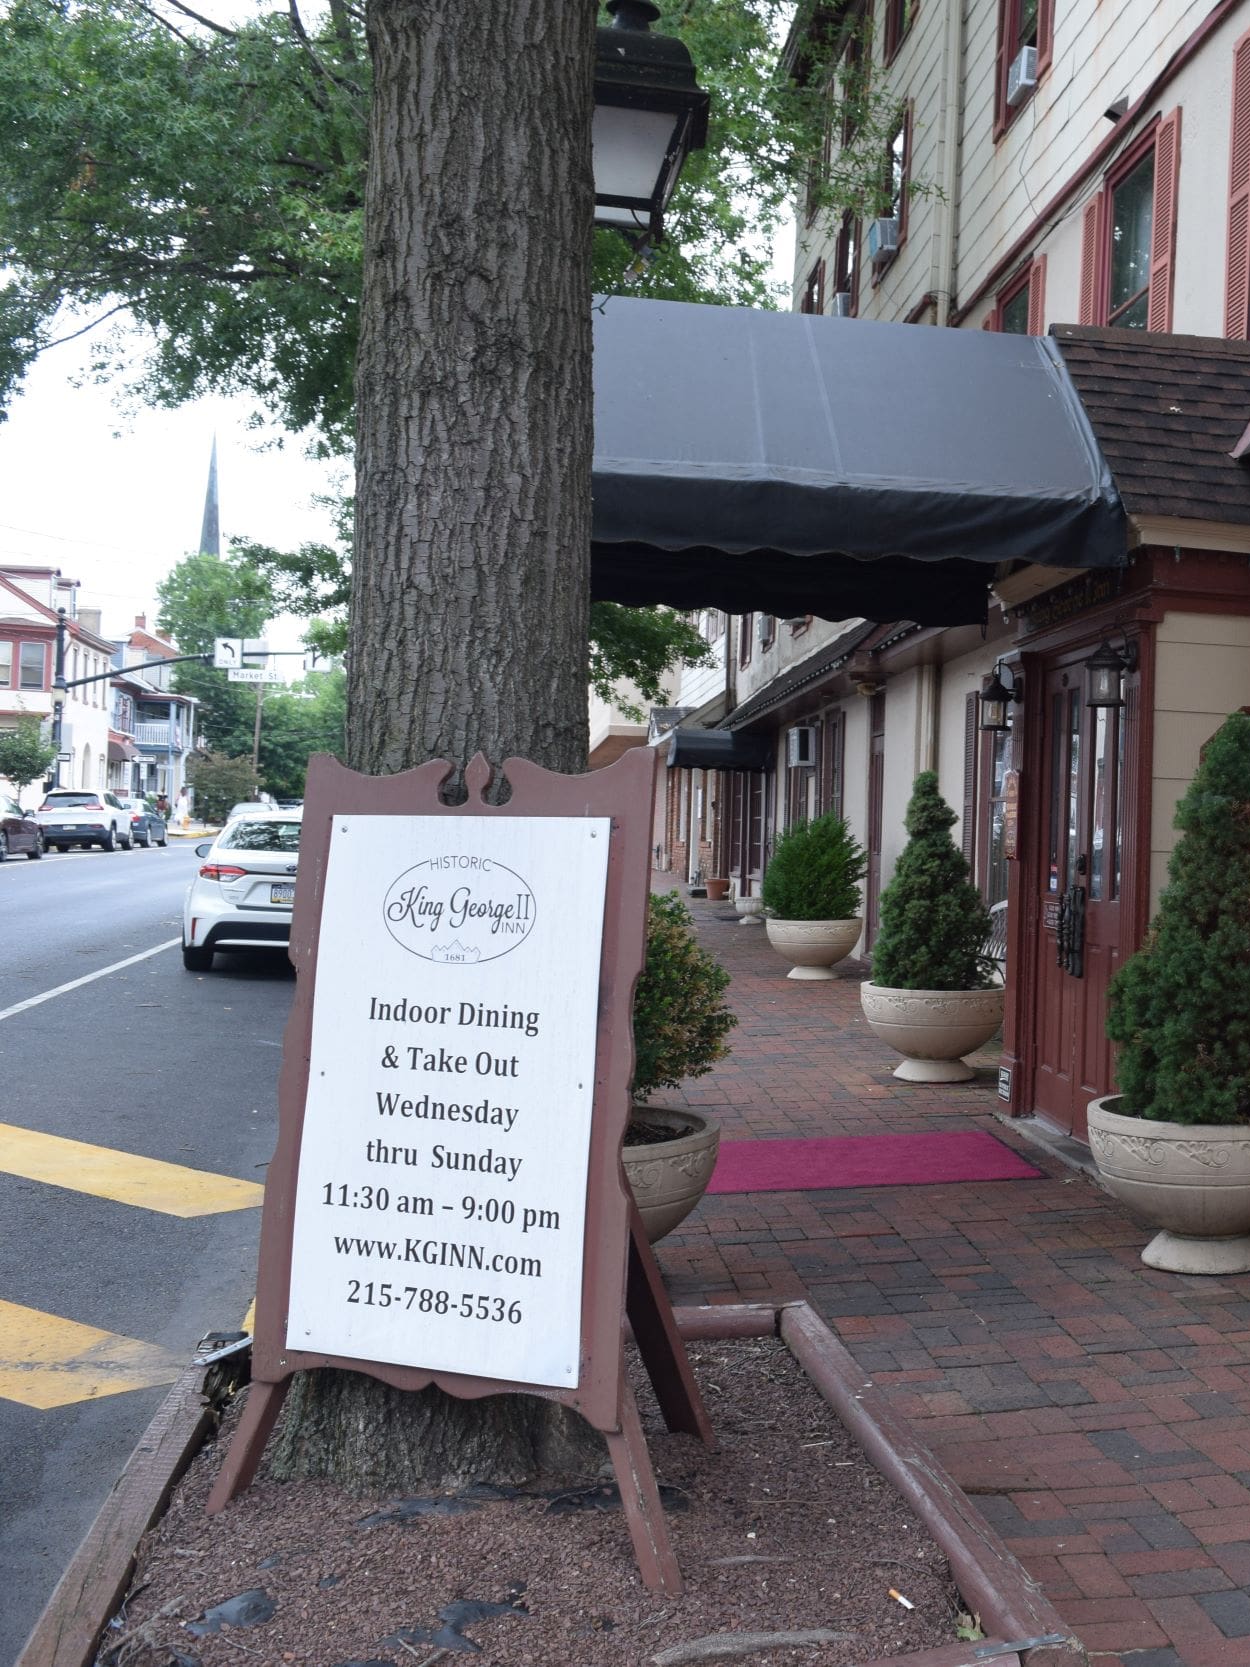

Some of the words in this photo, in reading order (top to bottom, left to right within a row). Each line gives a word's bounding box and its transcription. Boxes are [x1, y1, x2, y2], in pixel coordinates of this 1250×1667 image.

[233, 671, 264, 680] Market
[269, 672, 278, 681] St
[429, 855, 492, 872] HISTORIC
[387, 886, 444, 932] King
[449, 887, 514, 934] George
[501, 921, 525, 935] INN
[444, 953, 466, 963] 1681
[368, 997, 452, 1025] Indoor
[458, 1002, 540, 1037] Dining
[381, 1045, 400, 1069] &
[407, 1046, 468, 1074] Take
[475, 1051, 520, 1078] Out
[376, 1091, 520, 1133] Wednesday
[366, 1138, 418, 1167] thru
[431, 1144, 524, 1182] Sunday
[322, 1182, 390, 1211] 11:30
[396, 1194, 435, 1216] am
[461, 1195, 516, 1224] 9:00
[522, 1206, 561, 1233] pm
[334, 1236, 543, 1278] www.KGINN.com
[346, 1279, 523, 1325] 215-788-5536
